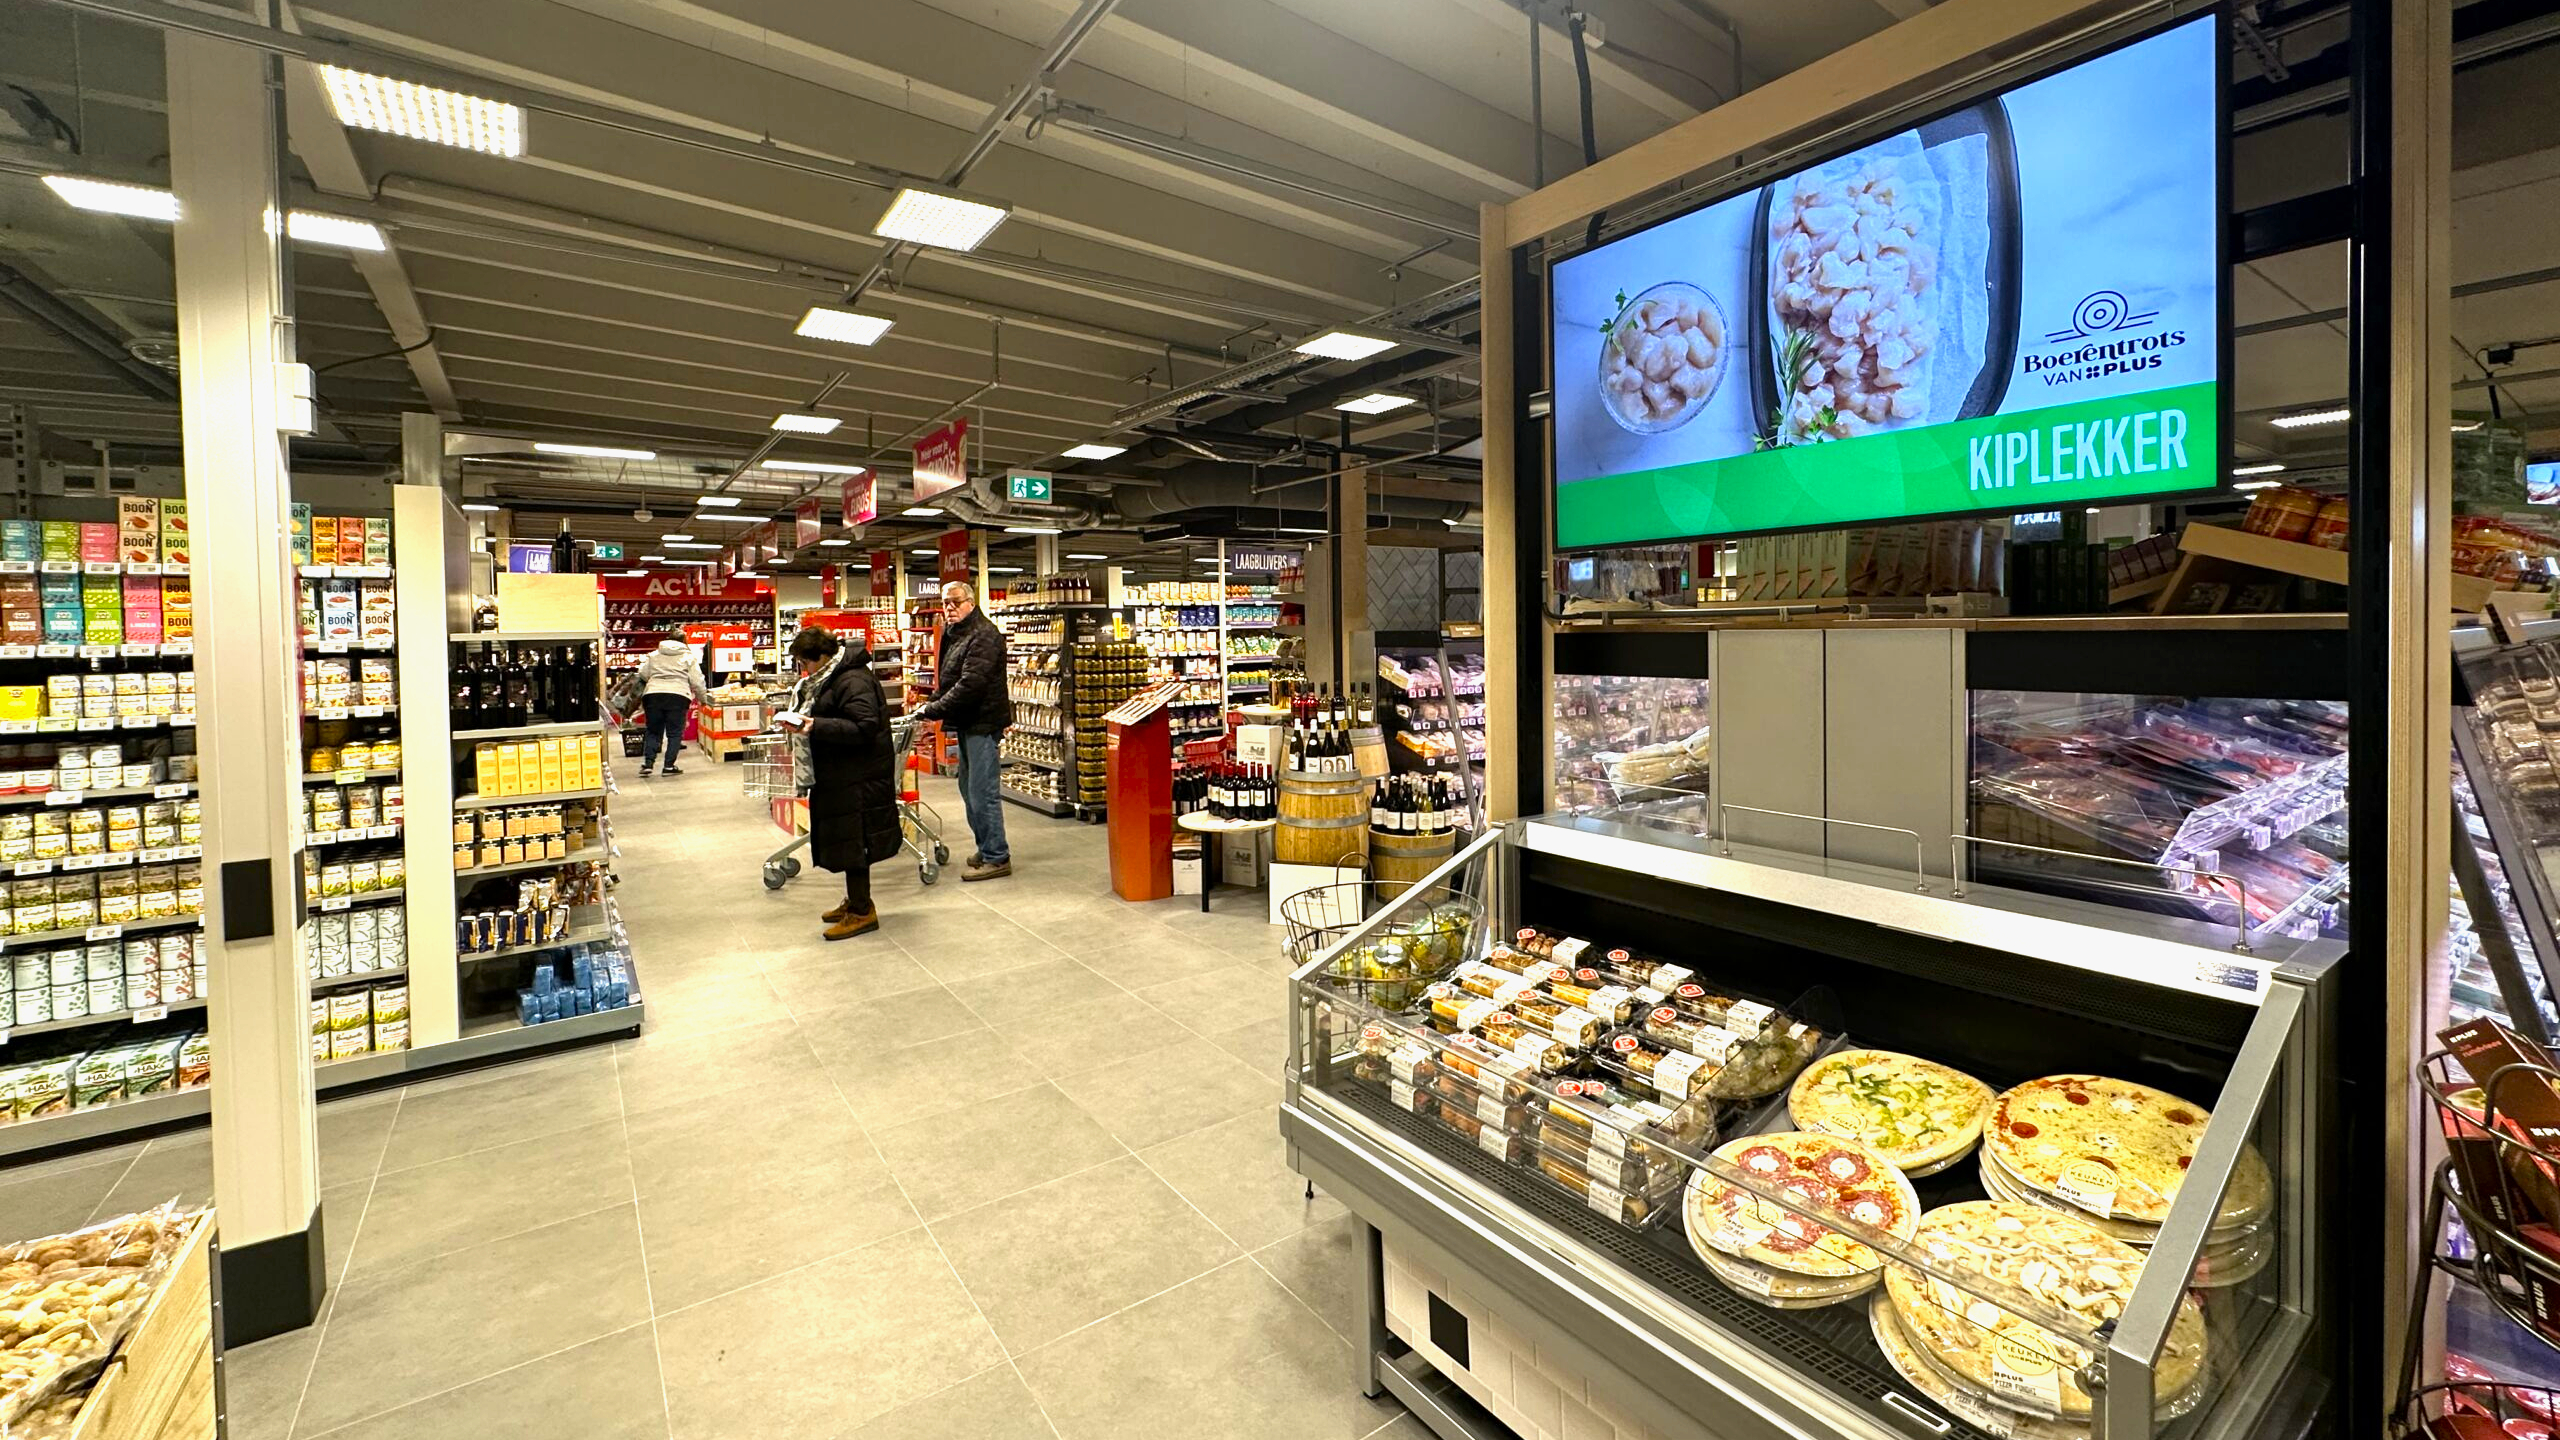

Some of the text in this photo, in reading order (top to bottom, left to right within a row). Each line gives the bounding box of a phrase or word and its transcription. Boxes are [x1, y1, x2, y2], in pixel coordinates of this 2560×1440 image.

[2023, 330, 2186, 374] Boerentrots
[2043, 354, 2162, 387] VAN PLUS
[1969, 408, 2188, 491] KIPLEKKER
[124, 503, 153, 513] BOON
[165, 505, 185, 514] BOO
[292, 509, 306, 518] ON
[315, 520, 334, 528] BOON
[368, 521, 386, 529] BOON
[124, 537, 153, 547] BOON
[166, 539, 187, 548] BOO
[292, 541, 306, 550] ON
[316, 546, 335, 554] BOON
[341, 546, 360, 554] BOON
[367, 546, 386, 554] BOON
[944, 551, 967, 573] ACTIE
[1235, 553, 1287, 570] LAAGBLIJVERS
[872, 567, 889, 584] ACTIE
[326, 584, 351, 593] BOON
[365, 585, 390, 593] BOON
[645, 578, 723, 596] ACTIE
[918, 582, 940, 595] LAAGB
[302, 616, 315, 626] ON
[328, 616, 353, 625] BOON
[365, 615, 390, 625] BOON
[691, 631, 713, 639] ACTI
[719, 632, 749, 641] ACTIE
[830, 628, 866, 639] CTIE
[136, 1063, 161, 1075] HAK
[87, 1071, 112, 1083] HAK
[27, 1081, 53, 1093] HAK
[2070, 1171, 2113, 1185] KEUKEN
[2062, 1186, 2081, 1197] PLUS
[2533, 1281, 2546, 1309] PLUS
[2002, 1344, 2050, 1362] KEUKEN
[2001, 1372, 2023, 1382] PLUS
[1995, 1379, 2012, 1389] PIZZA
